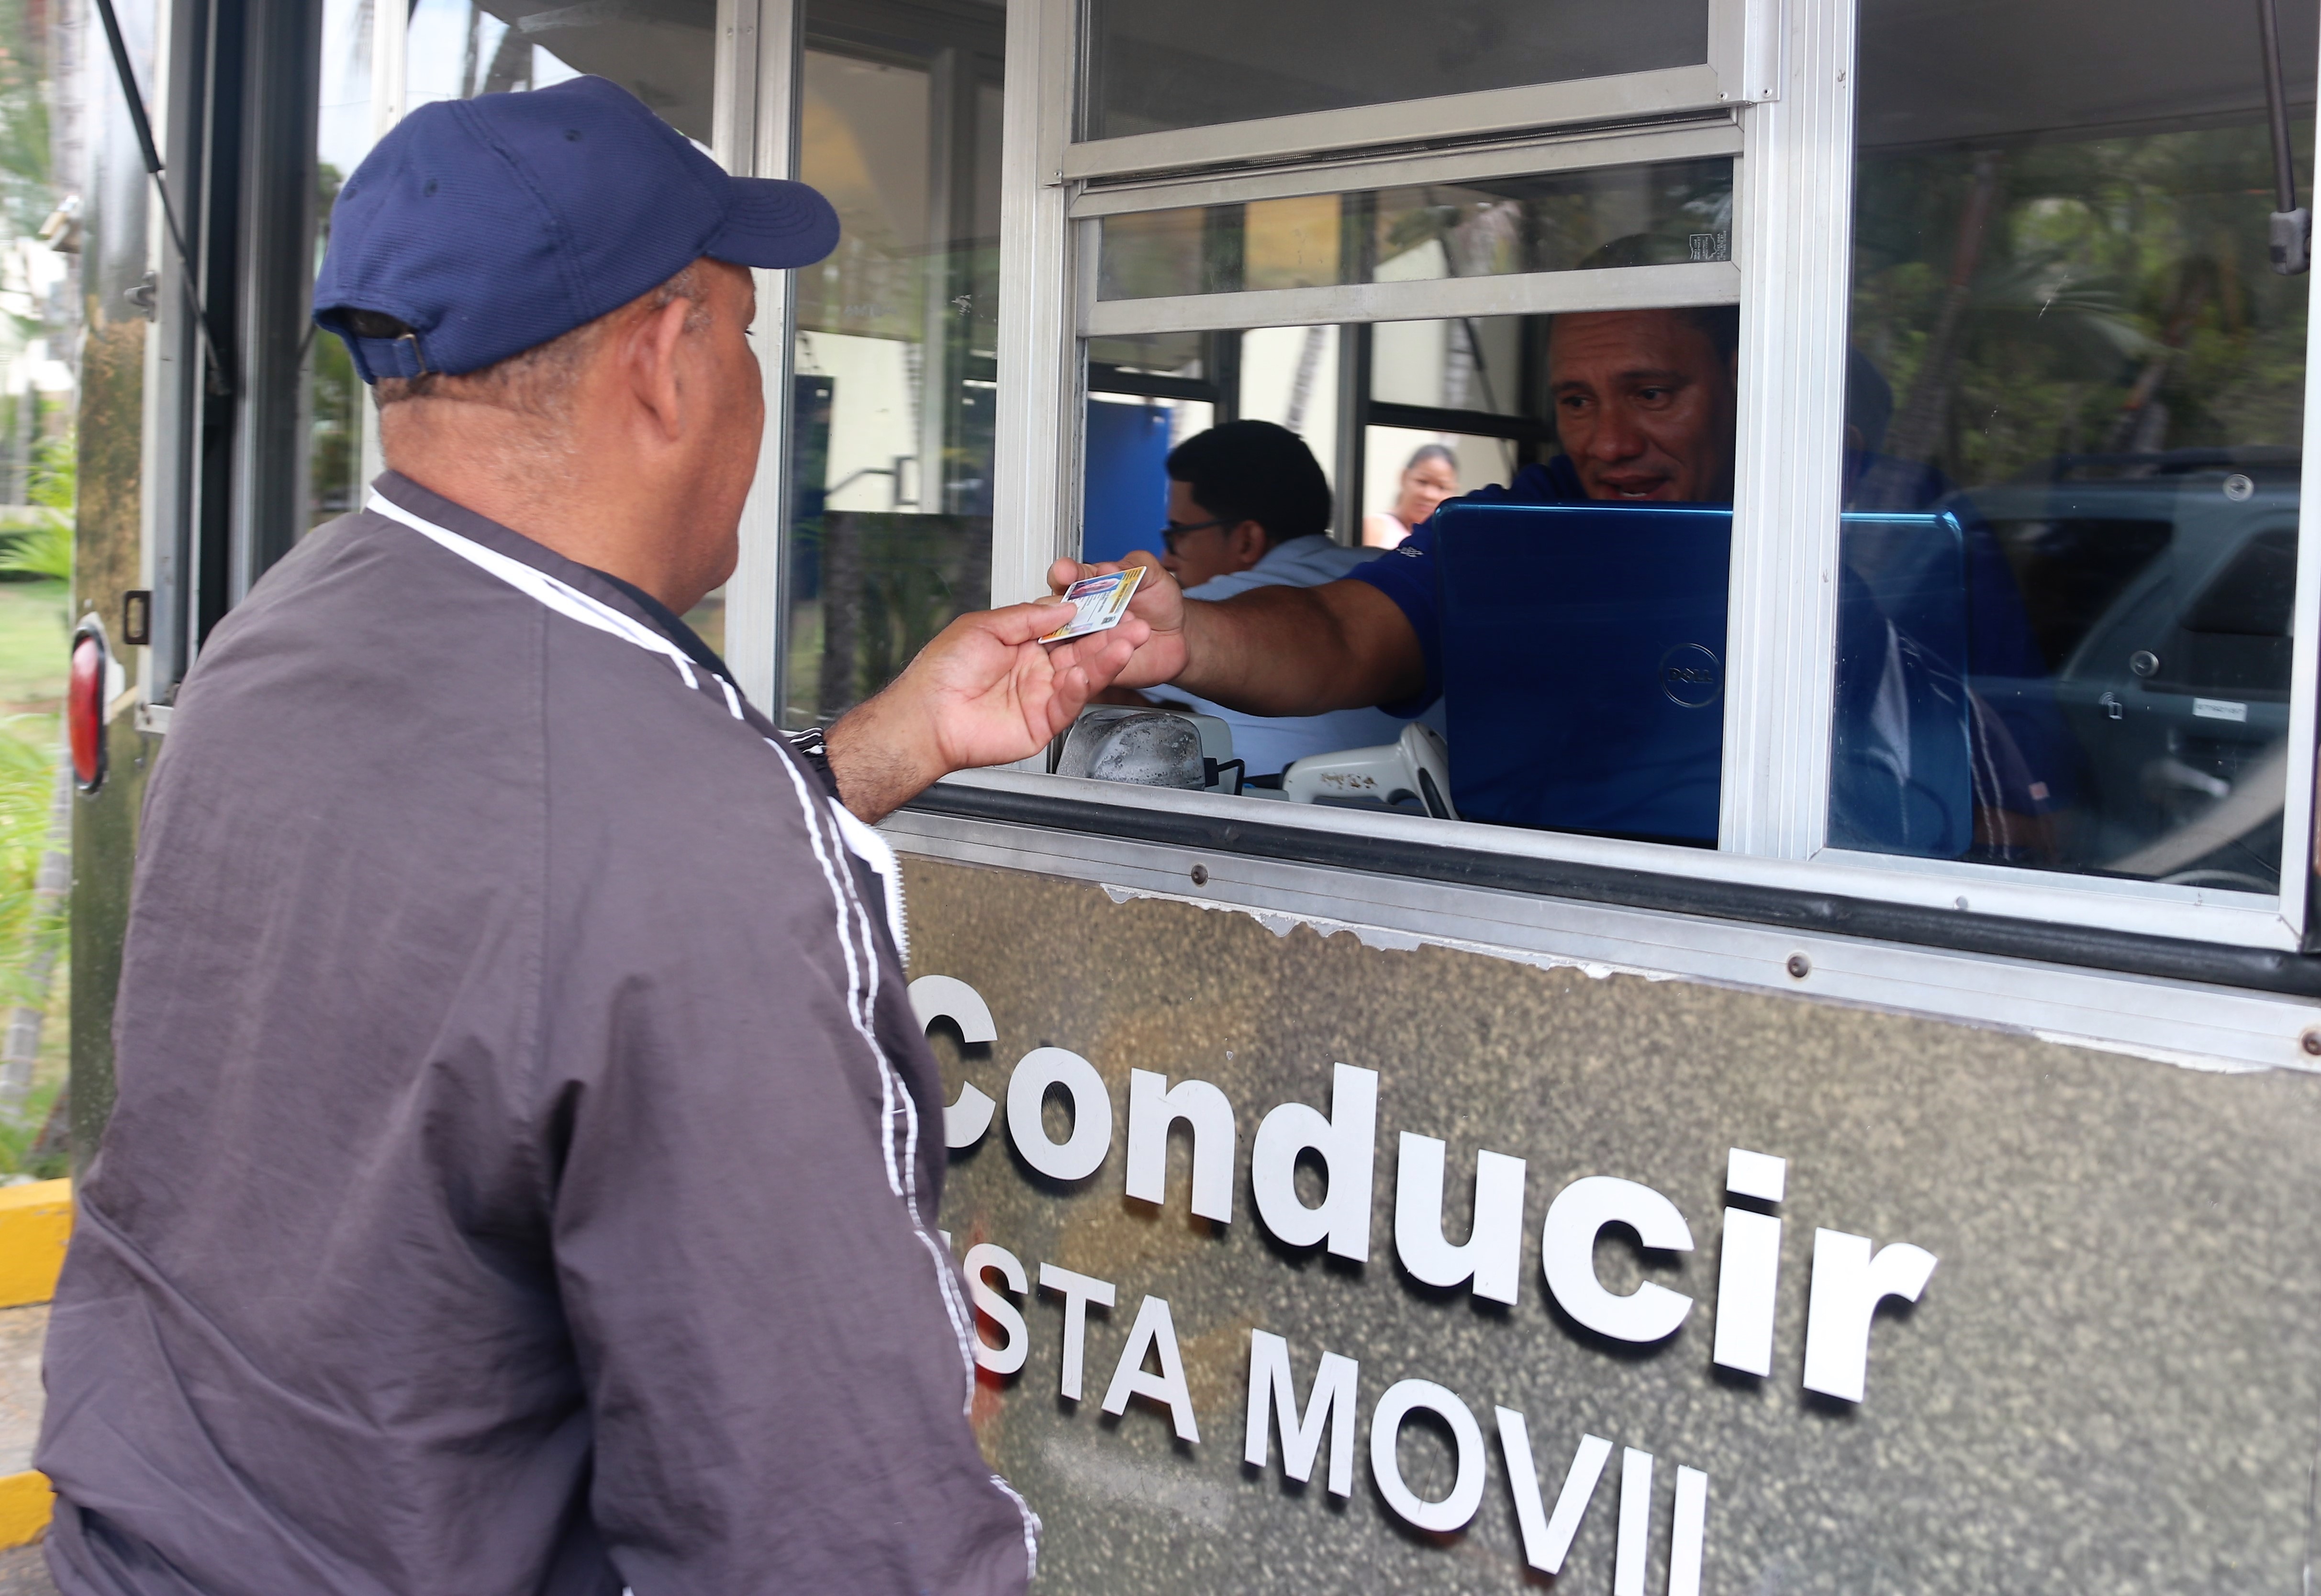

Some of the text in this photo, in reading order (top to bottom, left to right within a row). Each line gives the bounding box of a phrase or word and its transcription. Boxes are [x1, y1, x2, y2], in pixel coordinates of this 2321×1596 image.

[1667, 667, 1714, 684] DELL
[906, 974, 1937, 1403] Conducir
[937, 1229, 1200, 1445] STA
